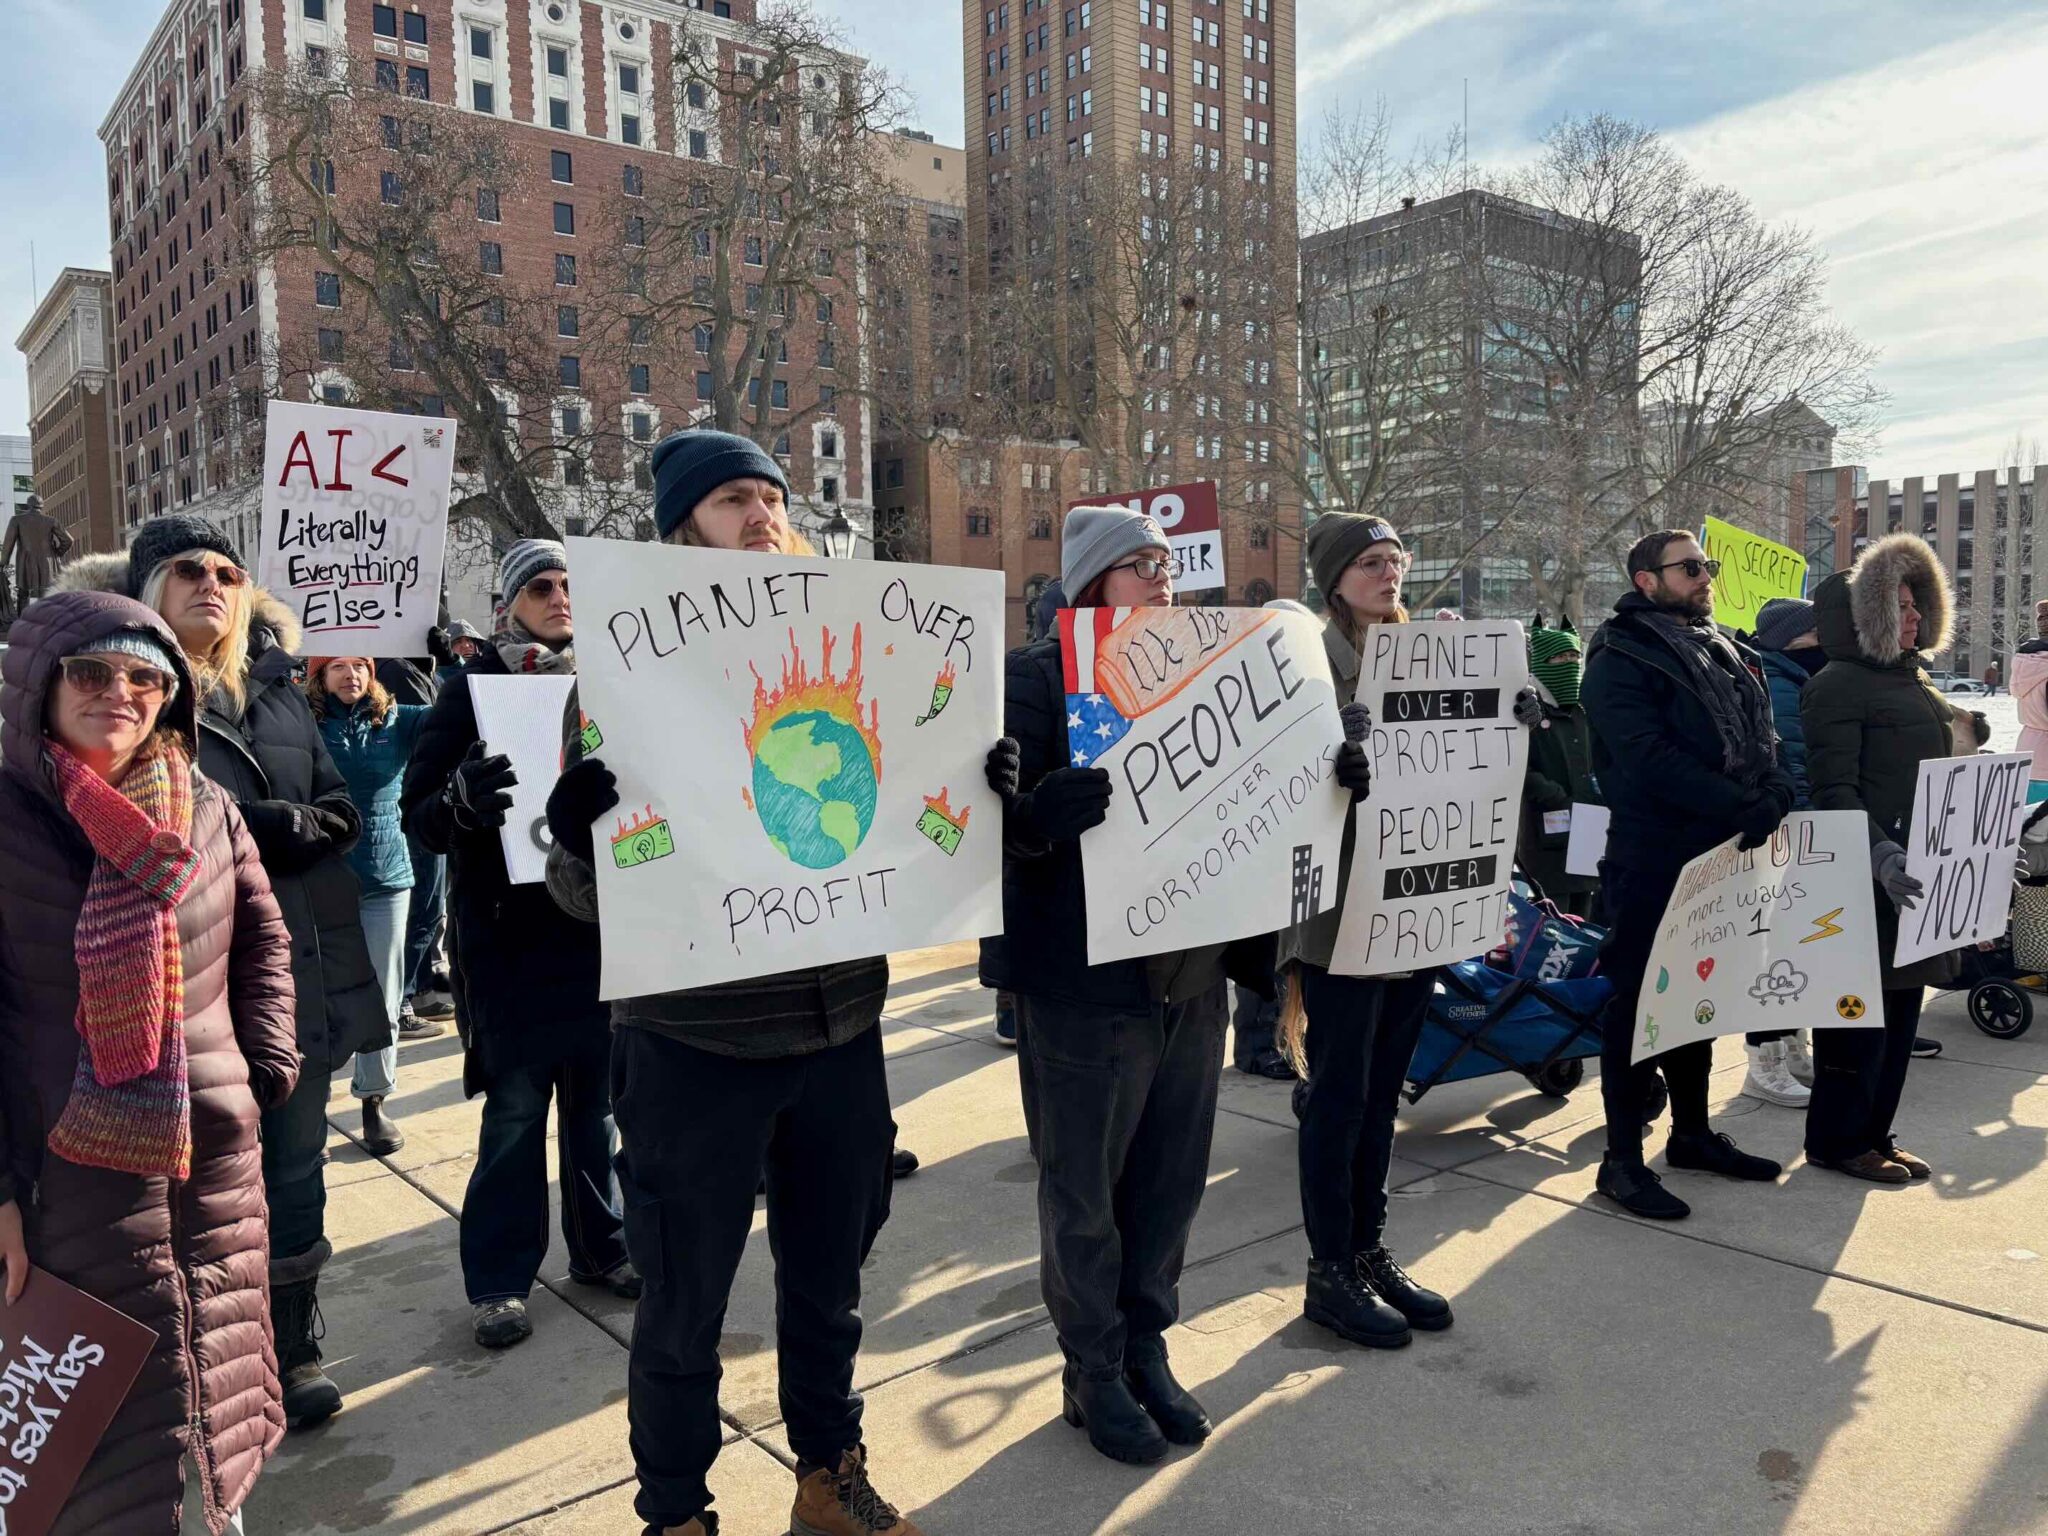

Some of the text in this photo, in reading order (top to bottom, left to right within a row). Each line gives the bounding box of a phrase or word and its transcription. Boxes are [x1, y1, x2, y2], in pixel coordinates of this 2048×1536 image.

[279, 430, 353, 492] AI
[278, 509, 387, 551] Literally
[288, 554, 418, 590] Everything
[1742, 541, 1801, 595] SECRET
[607, 572, 975, 673] PLANET OVER
[1116, 628, 1185, 692] We
[1373, 633, 1507, 681] PLANET
[1123, 626, 1305, 825] PEOPLE
[1397, 691, 1475, 720] OVER
[1372, 726, 1518, 780] PROFIT
[1216, 762, 1271, 821] OVER
[1925, 759, 2032, 857] WE VOTE
[1126, 744, 1335, 937] CORPORATIONS
[1379, 797, 1507, 860] PEOPLE
[723, 868, 896, 943] PROFIT
[1400, 860, 1479, 896] OVER
[1916, 852, 1989, 945] NO!
[1365, 890, 1507, 964] PROFIT
[1666, 882, 1807, 942] in more ways
[1690, 908, 1771, 951] than 1
[42, 1333, 105, 1403] Say
[10, 1394, 61, 1465] yes
